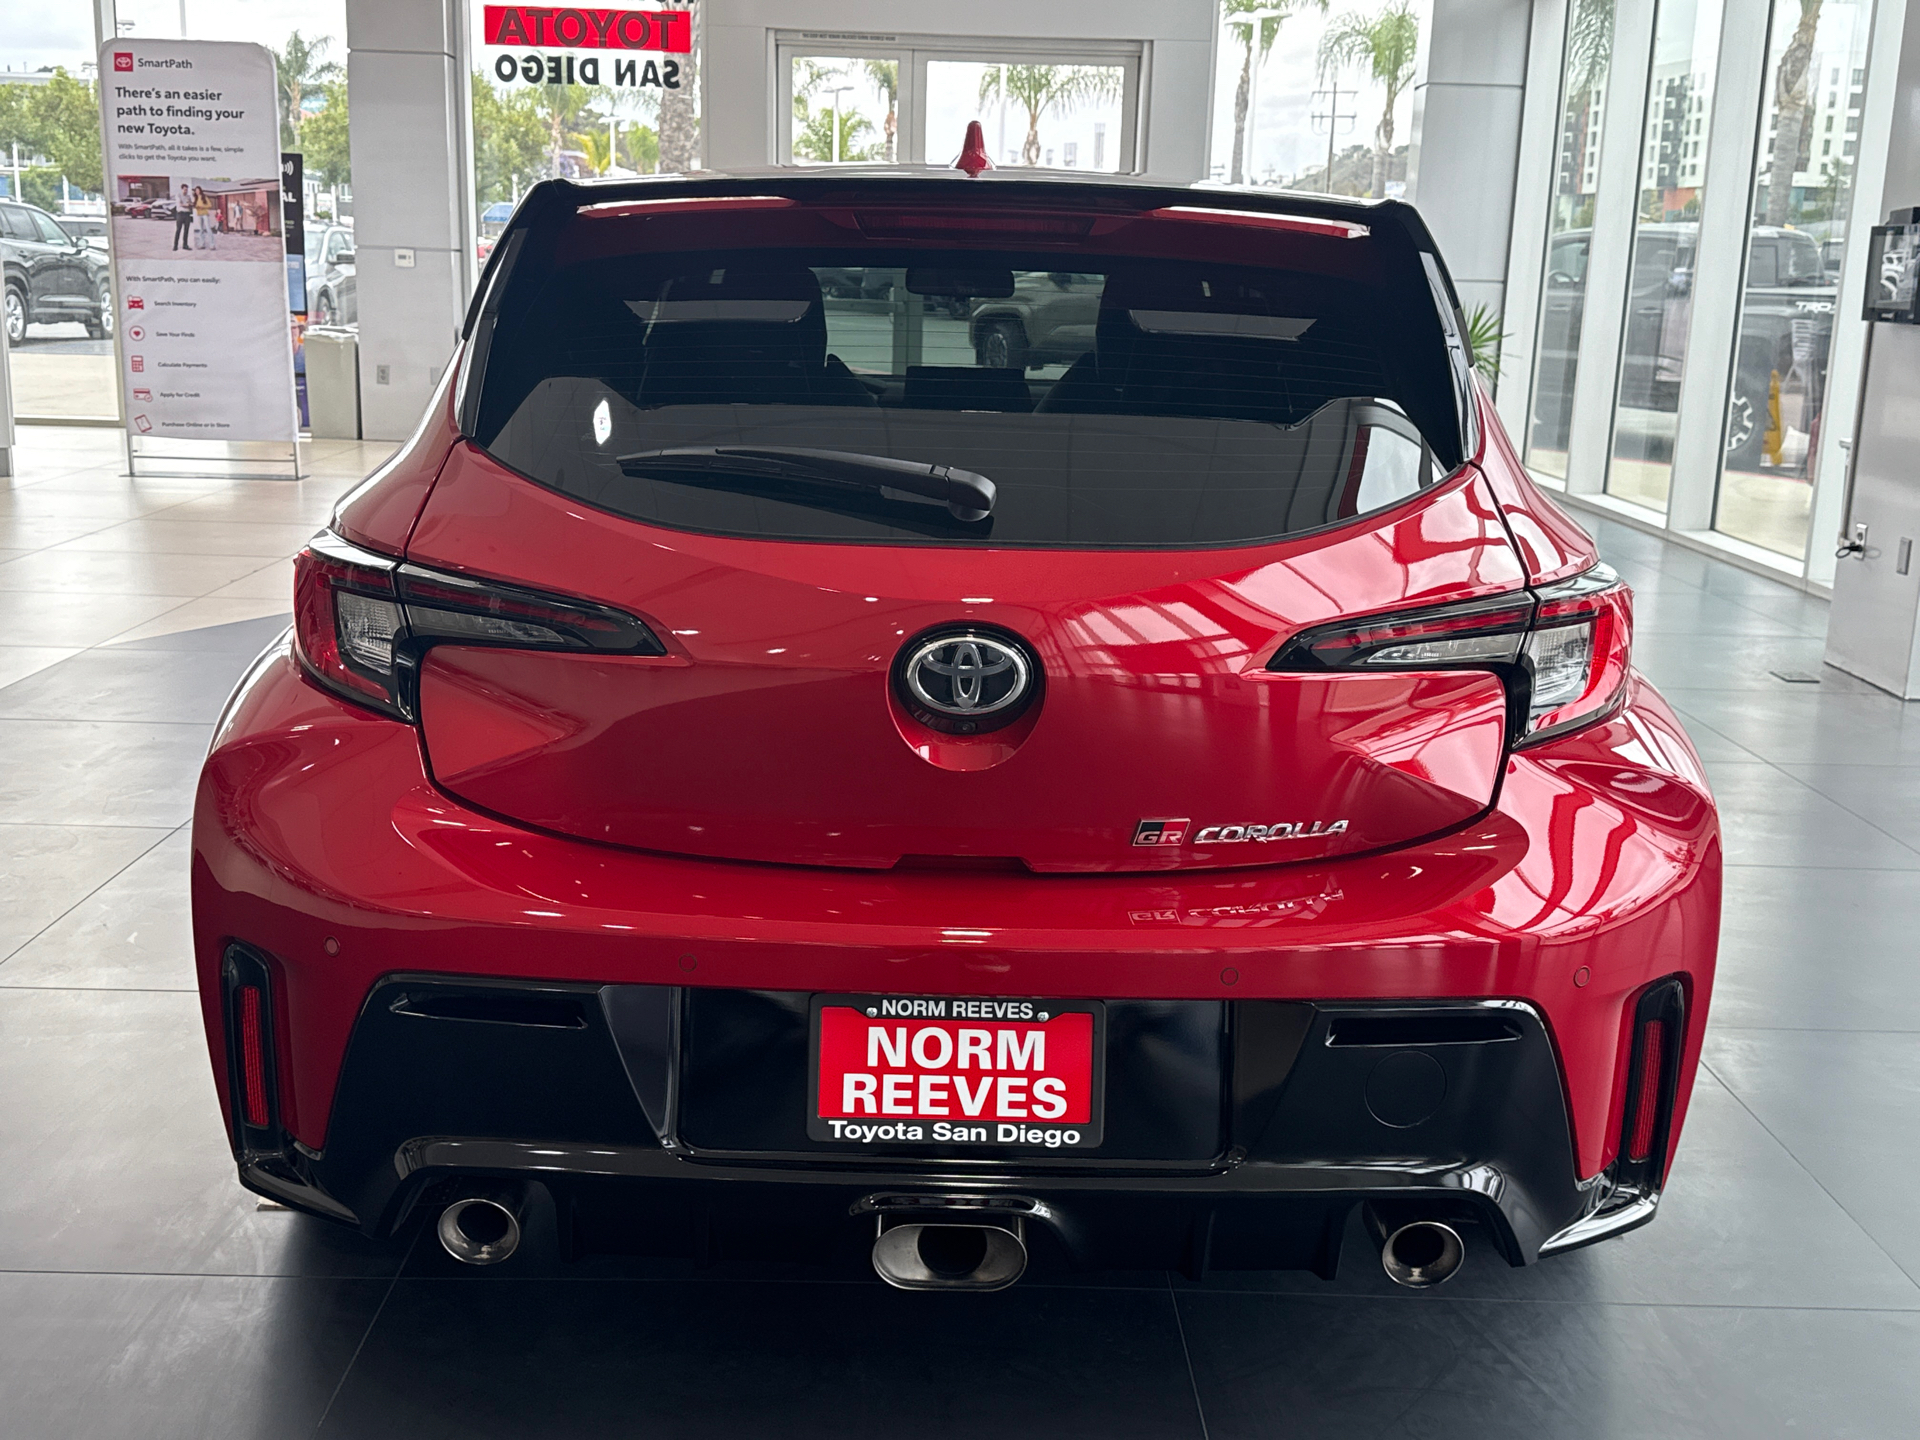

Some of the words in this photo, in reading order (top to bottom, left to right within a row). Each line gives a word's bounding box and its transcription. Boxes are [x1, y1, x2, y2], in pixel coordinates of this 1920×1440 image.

[137, 58, 193, 69] SmartPath
[115, 86, 162, 99] There's
[164, 90, 181, 100] an
[183, 89, 222, 101] easier
[116, 104, 147, 118] path
[149, 106, 163, 116] to
[166, 105, 213, 121] finding
[215, 110, 245, 121] your
[117, 124, 145, 134] new
[147, 123, 195, 137] Toyota.
[167, 154, 187, 162] Toyota
[224, 146, 244, 154] simple
[1136, 829, 1184, 845] GR
[1194, 819, 1349, 844] COROLLA
[881, 999, 946, 1018] NORM
[952, 1001, 1033, 1020] REEVES
[867, 1026, 1046, 1072] NORM
[842, 1073, 1068, 1119] REEVES
[828, 1120, 923, 1143] Toyota
[932, 1122, 987, 1143] San
[997, 1124, 1081, 1148] Diego
